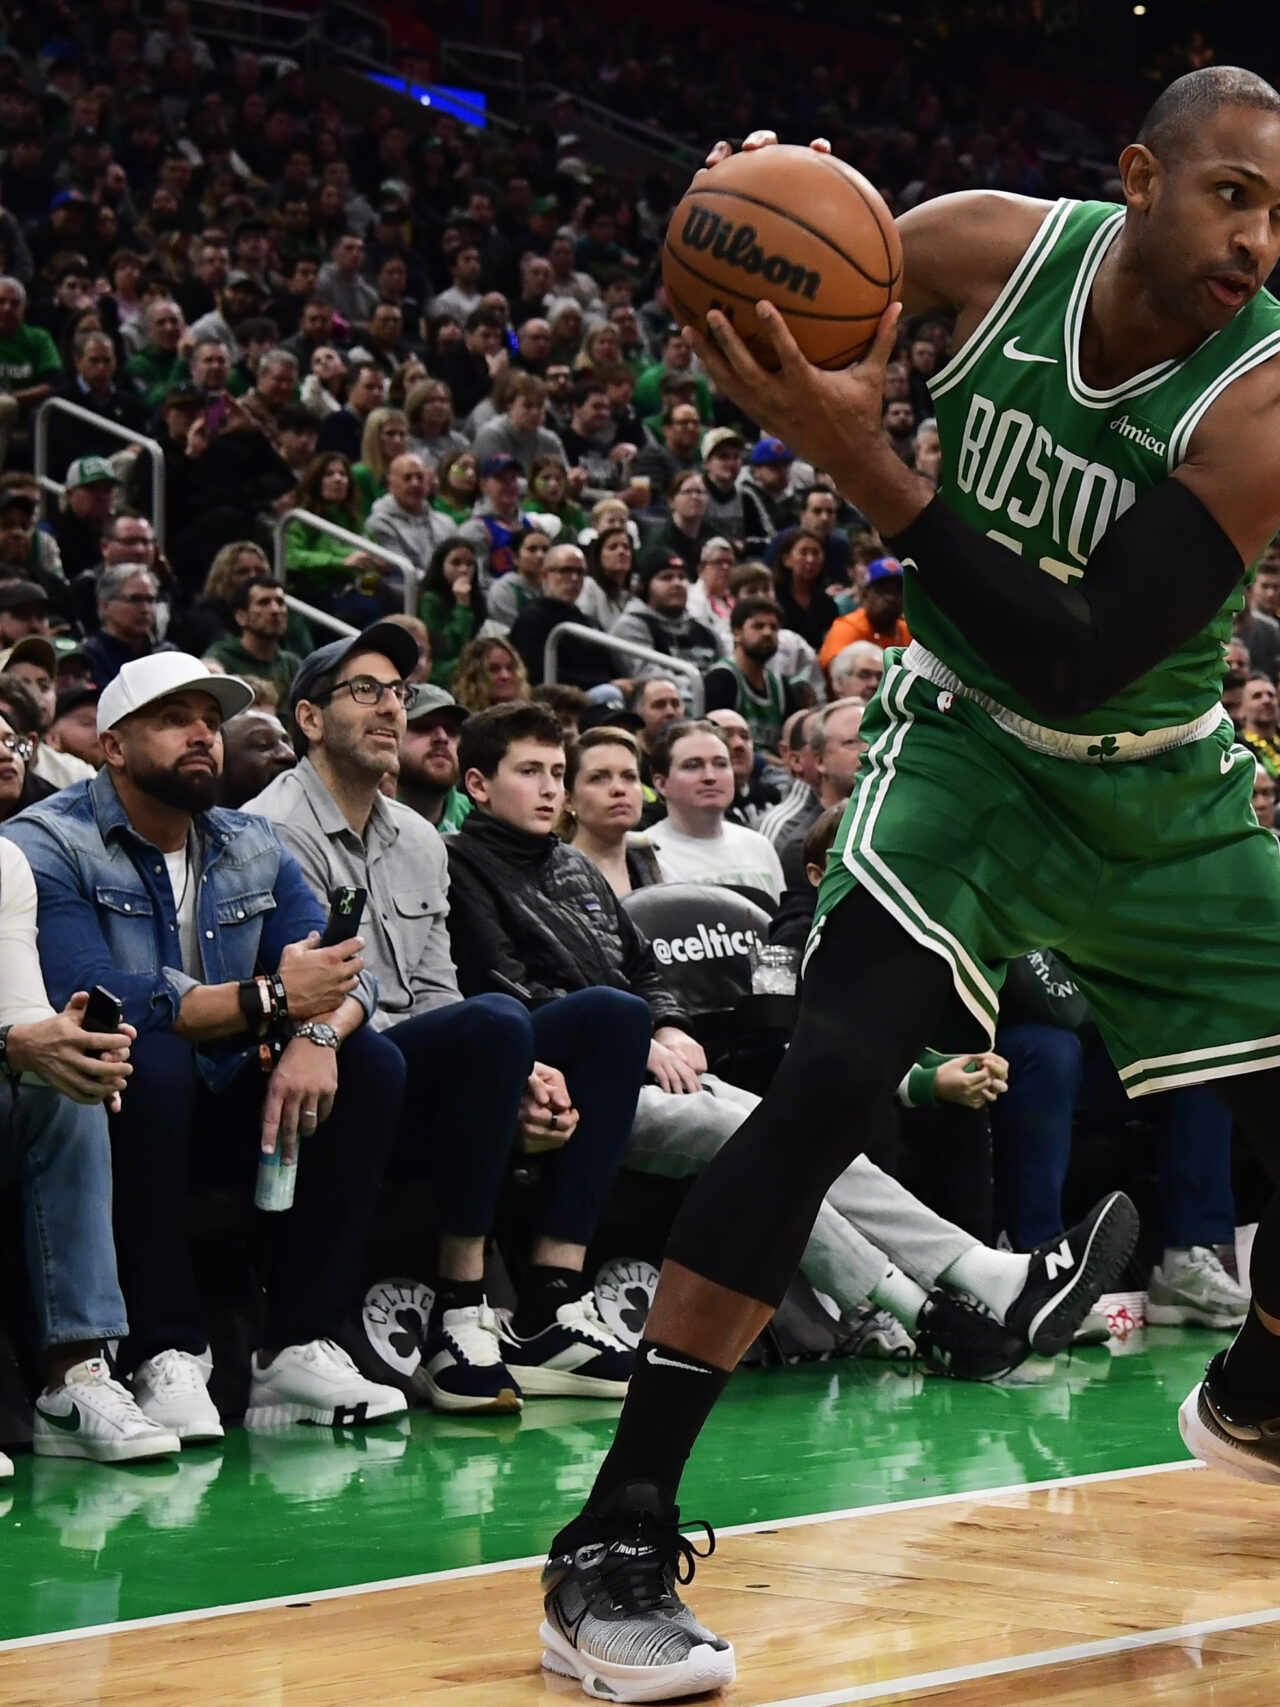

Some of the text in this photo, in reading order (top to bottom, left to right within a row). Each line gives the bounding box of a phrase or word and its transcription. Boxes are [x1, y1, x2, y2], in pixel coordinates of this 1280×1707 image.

[682, 203, 822, 301] Wilson
[1110, 415, 1167, 457] Amica
[652, 922, 763, 965] @celtics
[600, 1262, 659, 1302] CELTIC
[367, 1284, 433, 1325] CELTIC
